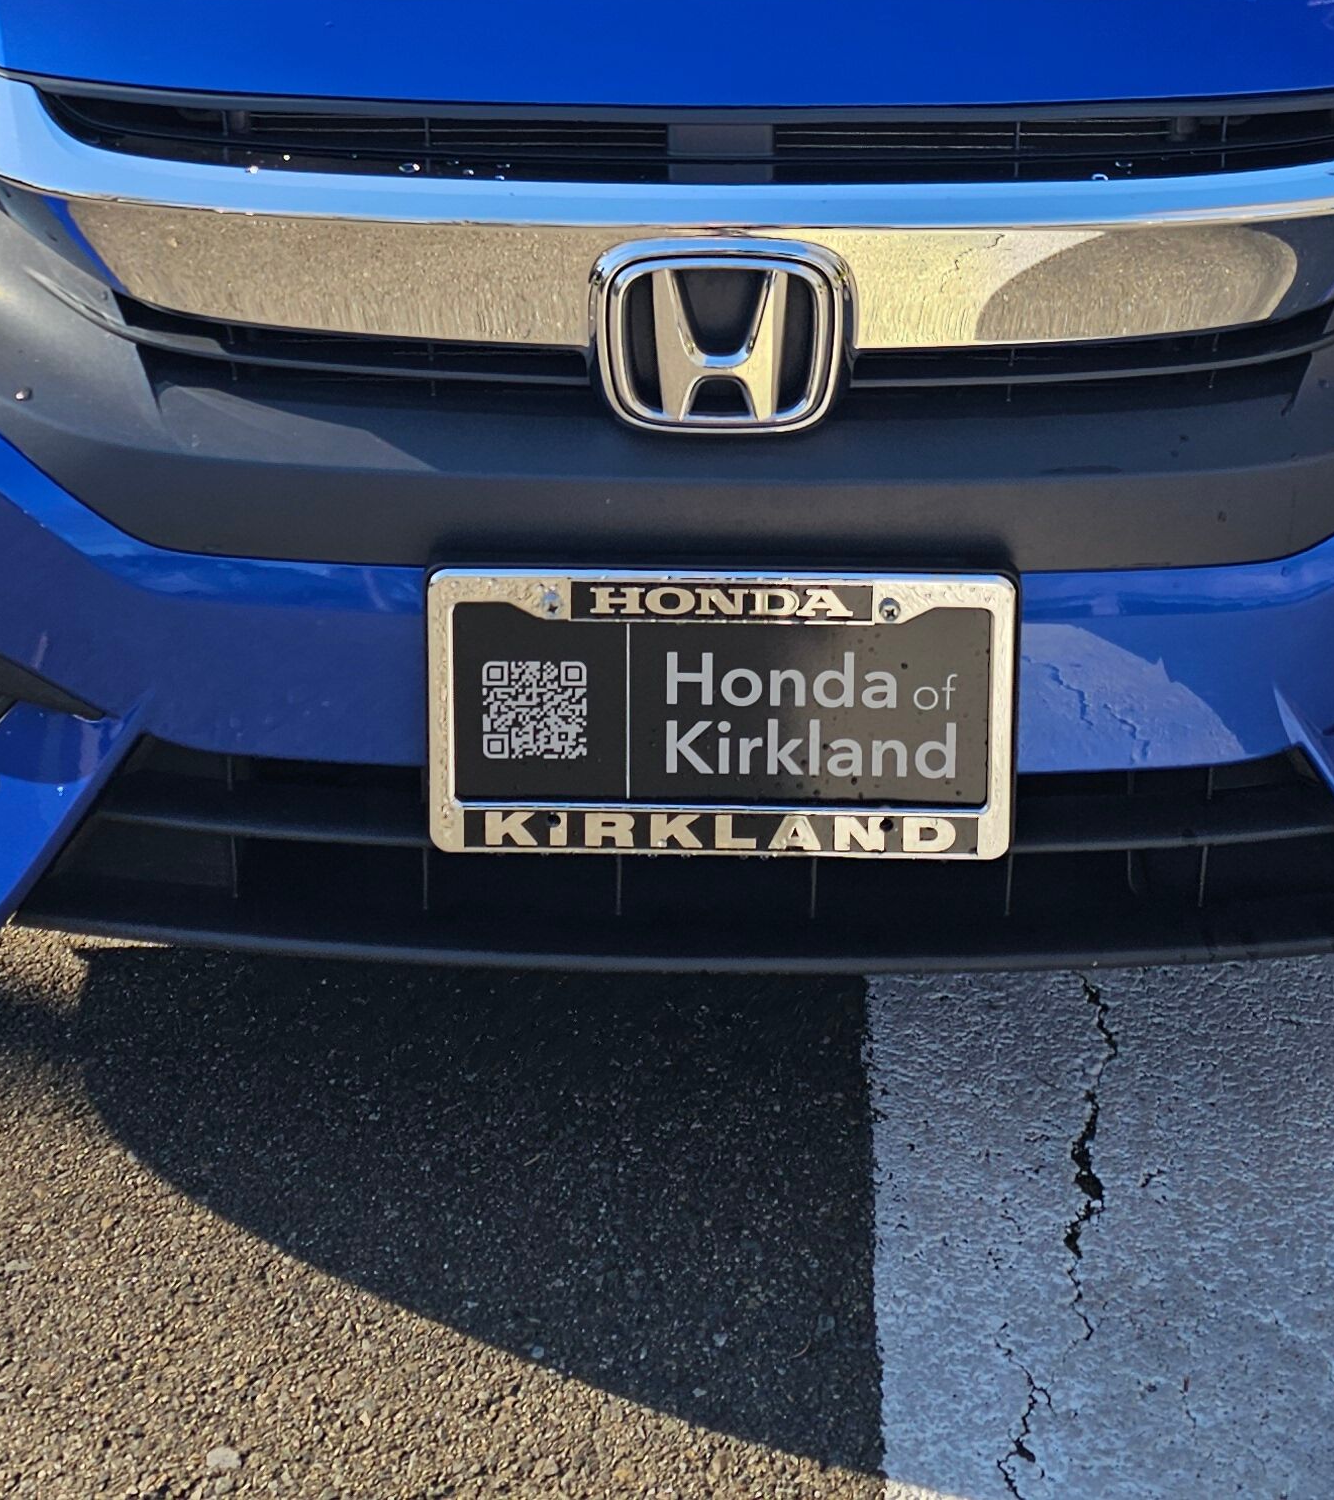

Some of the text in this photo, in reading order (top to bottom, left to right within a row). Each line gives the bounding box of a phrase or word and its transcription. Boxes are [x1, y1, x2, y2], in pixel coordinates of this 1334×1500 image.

[589, 586, 854, 618] HONDA
[666, 651, 958, 710] Honda of
[666, 718, 956, 780] Kirkland
[484, 810, 957, 853] KIRKLAND
